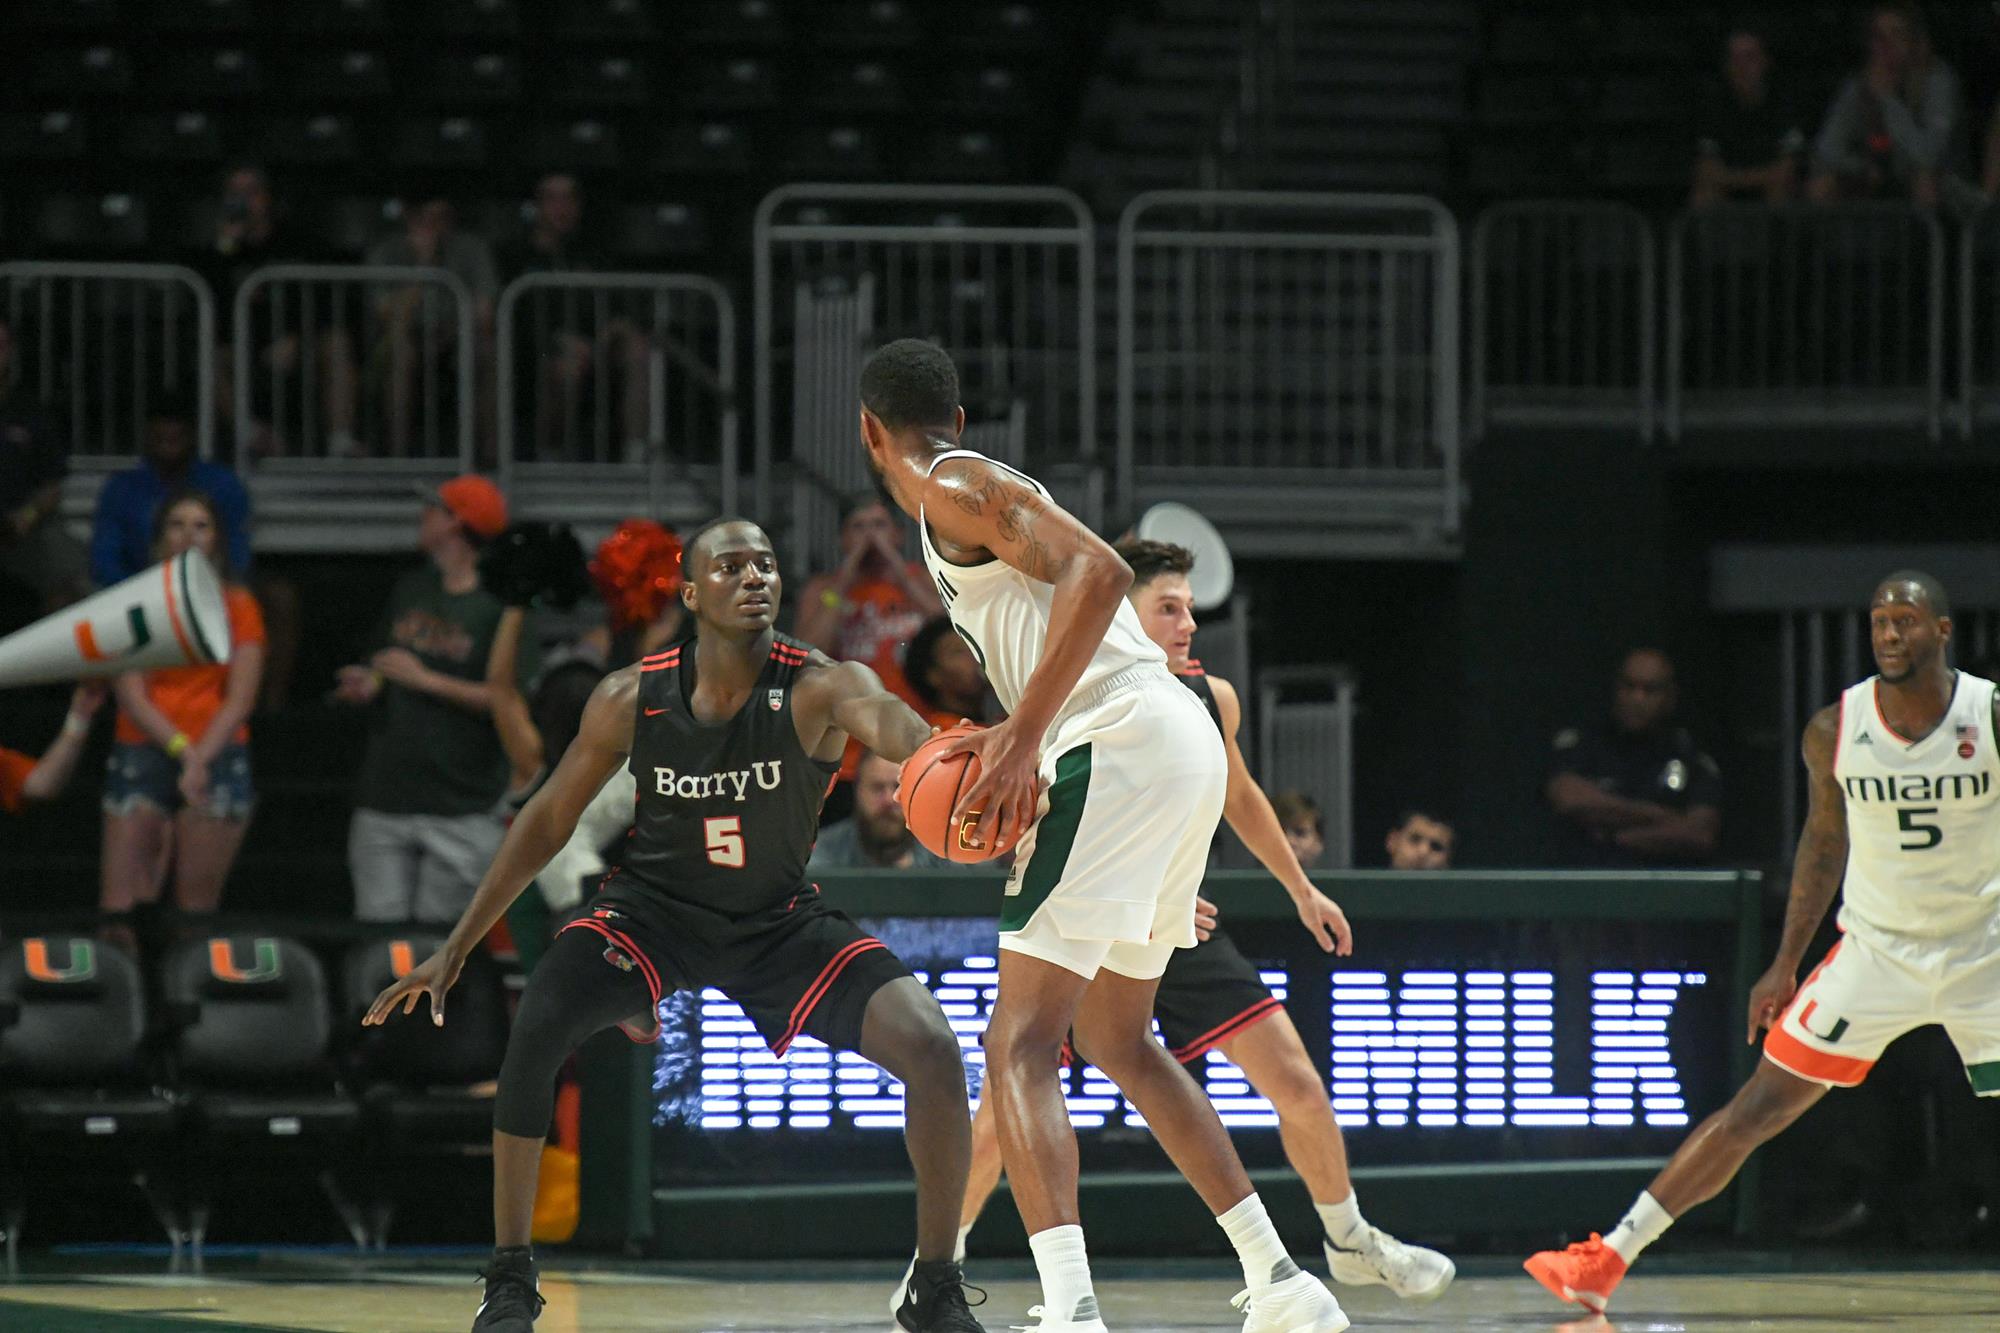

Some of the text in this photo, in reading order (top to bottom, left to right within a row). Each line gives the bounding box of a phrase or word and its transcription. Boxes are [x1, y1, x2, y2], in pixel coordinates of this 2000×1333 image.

[703, 815, 746, 869] 5
[1897, 807, 1943, 851] 5
[24, 938, 96, 983] U
[209, 938, 281, 983] U
[1798, 998, 1850, 1044] U
[1331, 971, 1690, 1126] MILK
